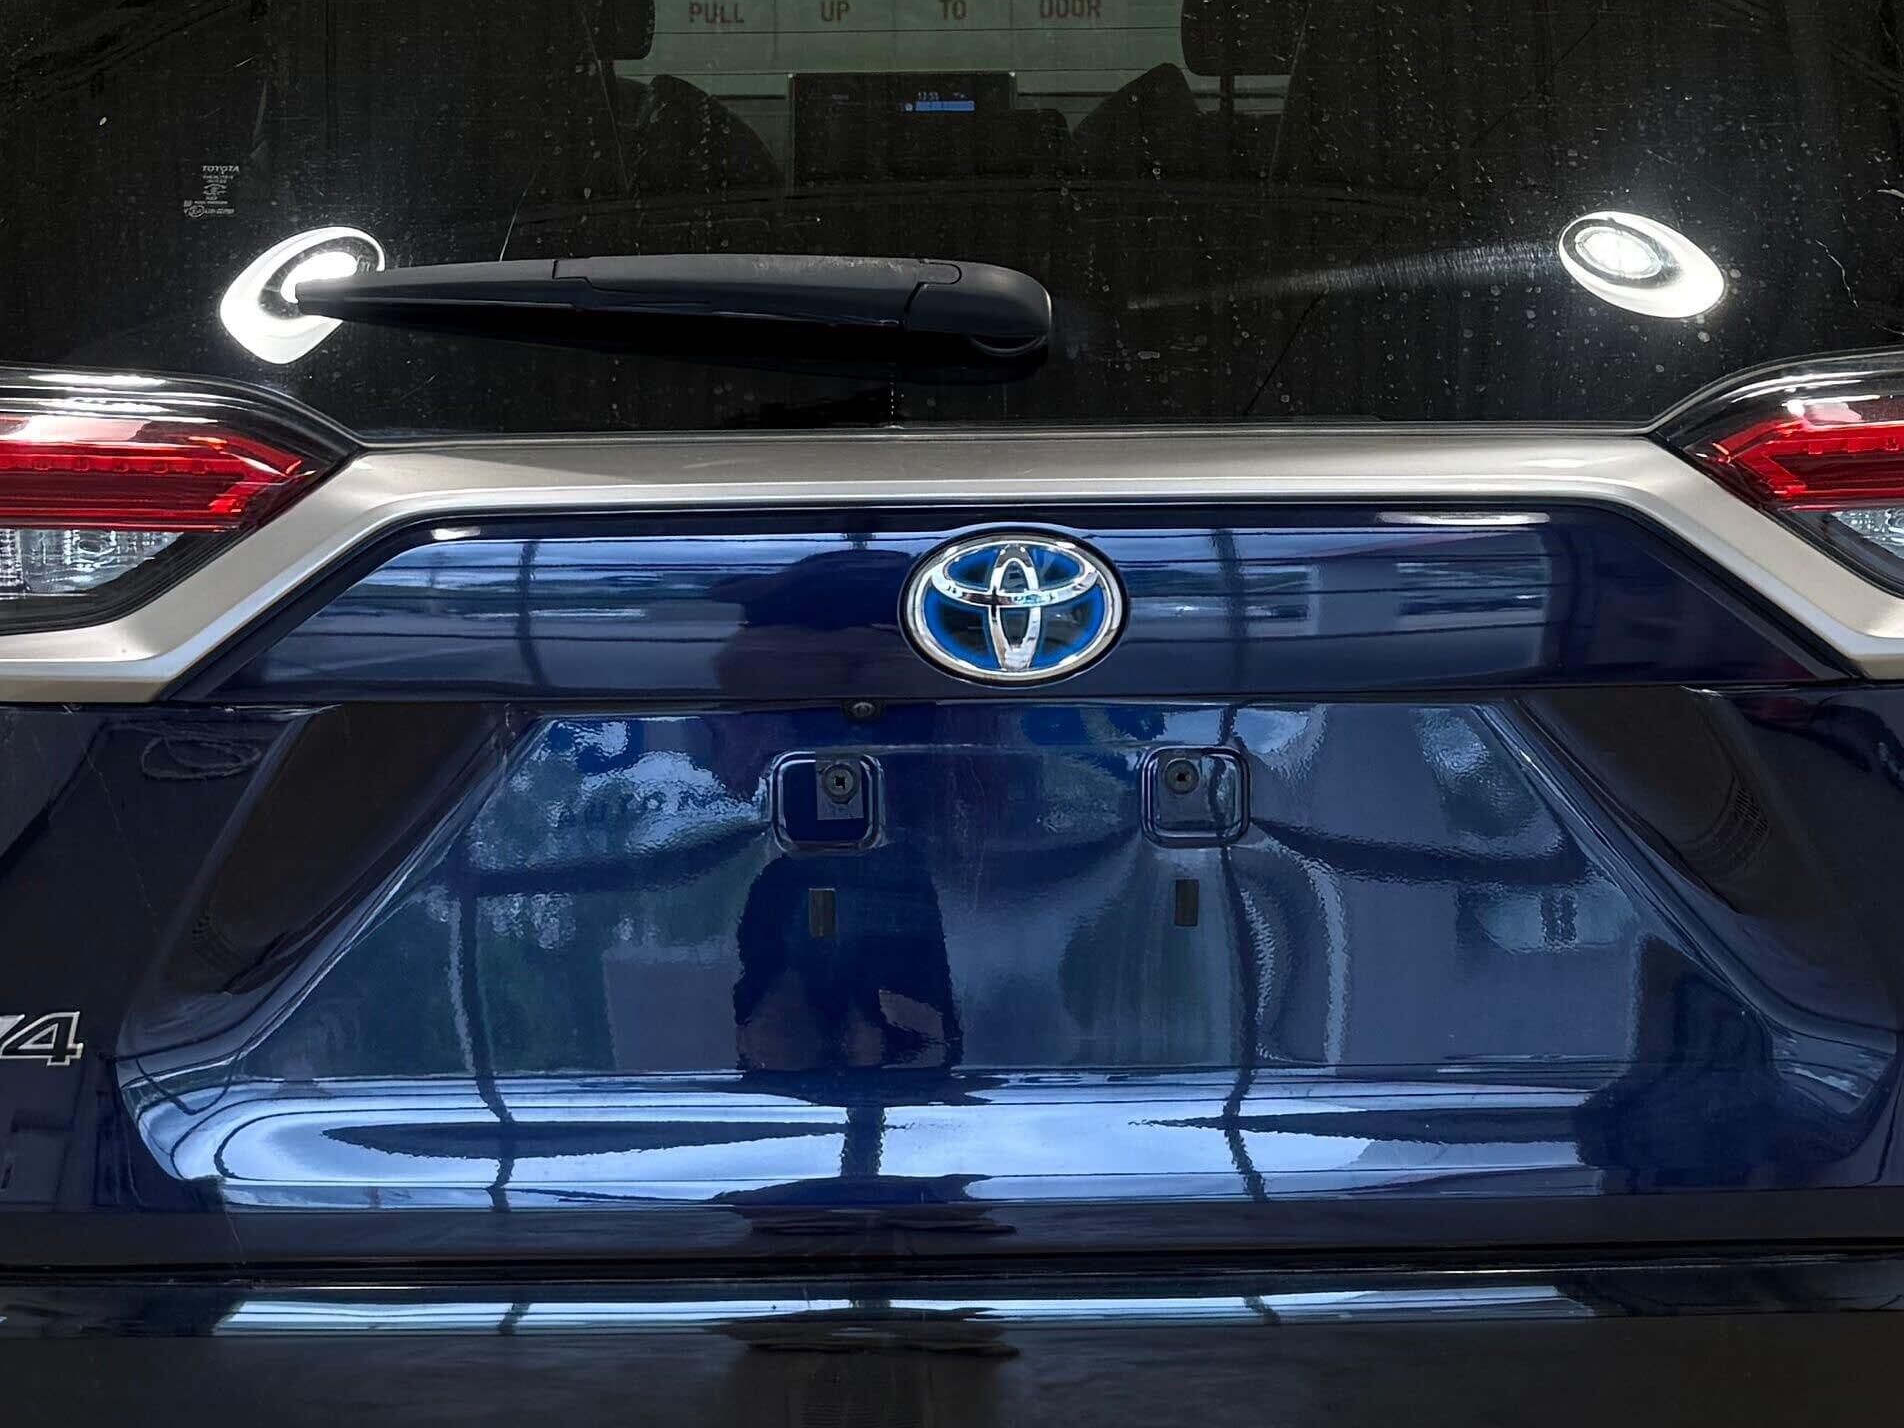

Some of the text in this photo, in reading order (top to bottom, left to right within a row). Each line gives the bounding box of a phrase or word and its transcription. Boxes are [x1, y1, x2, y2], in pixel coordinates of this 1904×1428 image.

[689, 1, 745, 24] PULL
[821, 0, 850, 22] UP
[202, 165, 239, 173] TOYOTA
